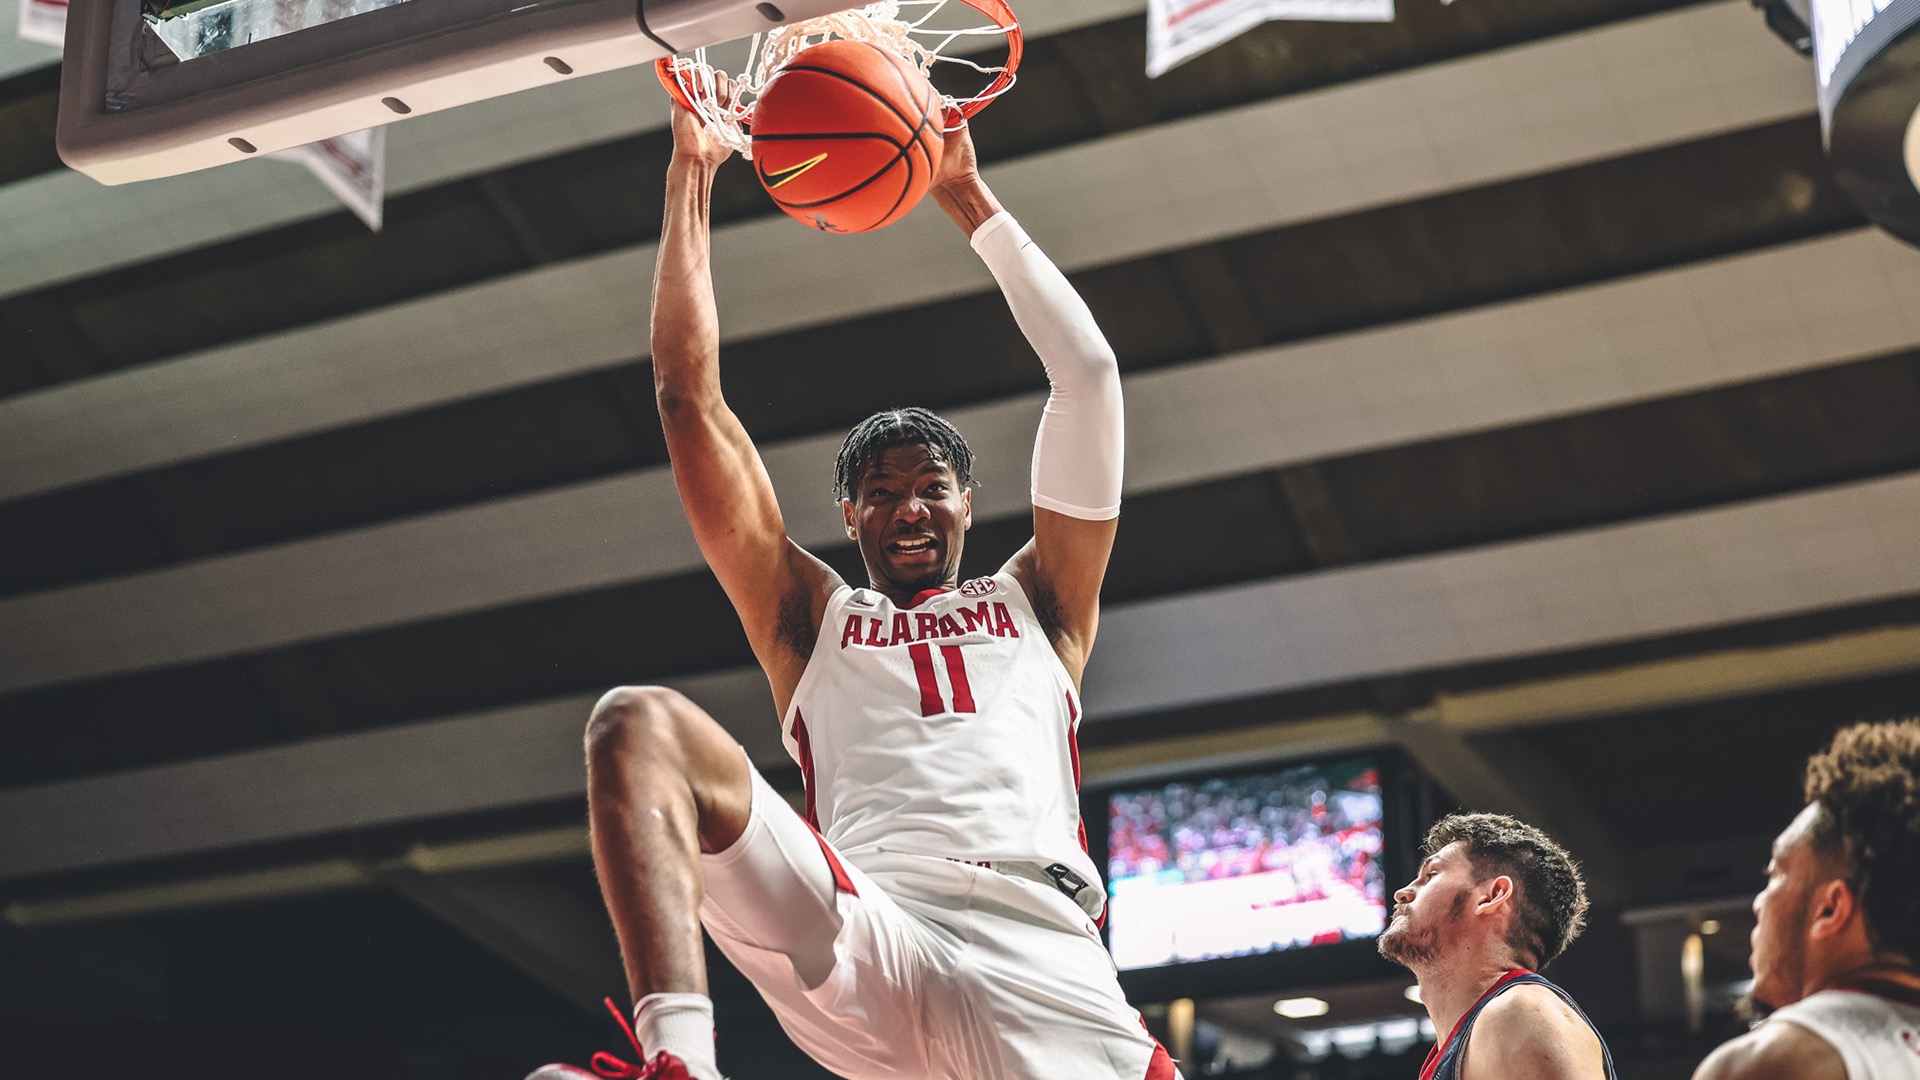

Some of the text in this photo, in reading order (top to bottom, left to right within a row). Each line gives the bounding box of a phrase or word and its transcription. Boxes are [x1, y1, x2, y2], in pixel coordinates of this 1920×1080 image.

[961, 578, 995, 596] SEC
[841, 602, 1020, 650] ALABAMA
[908, 642, 977, 718] 11
